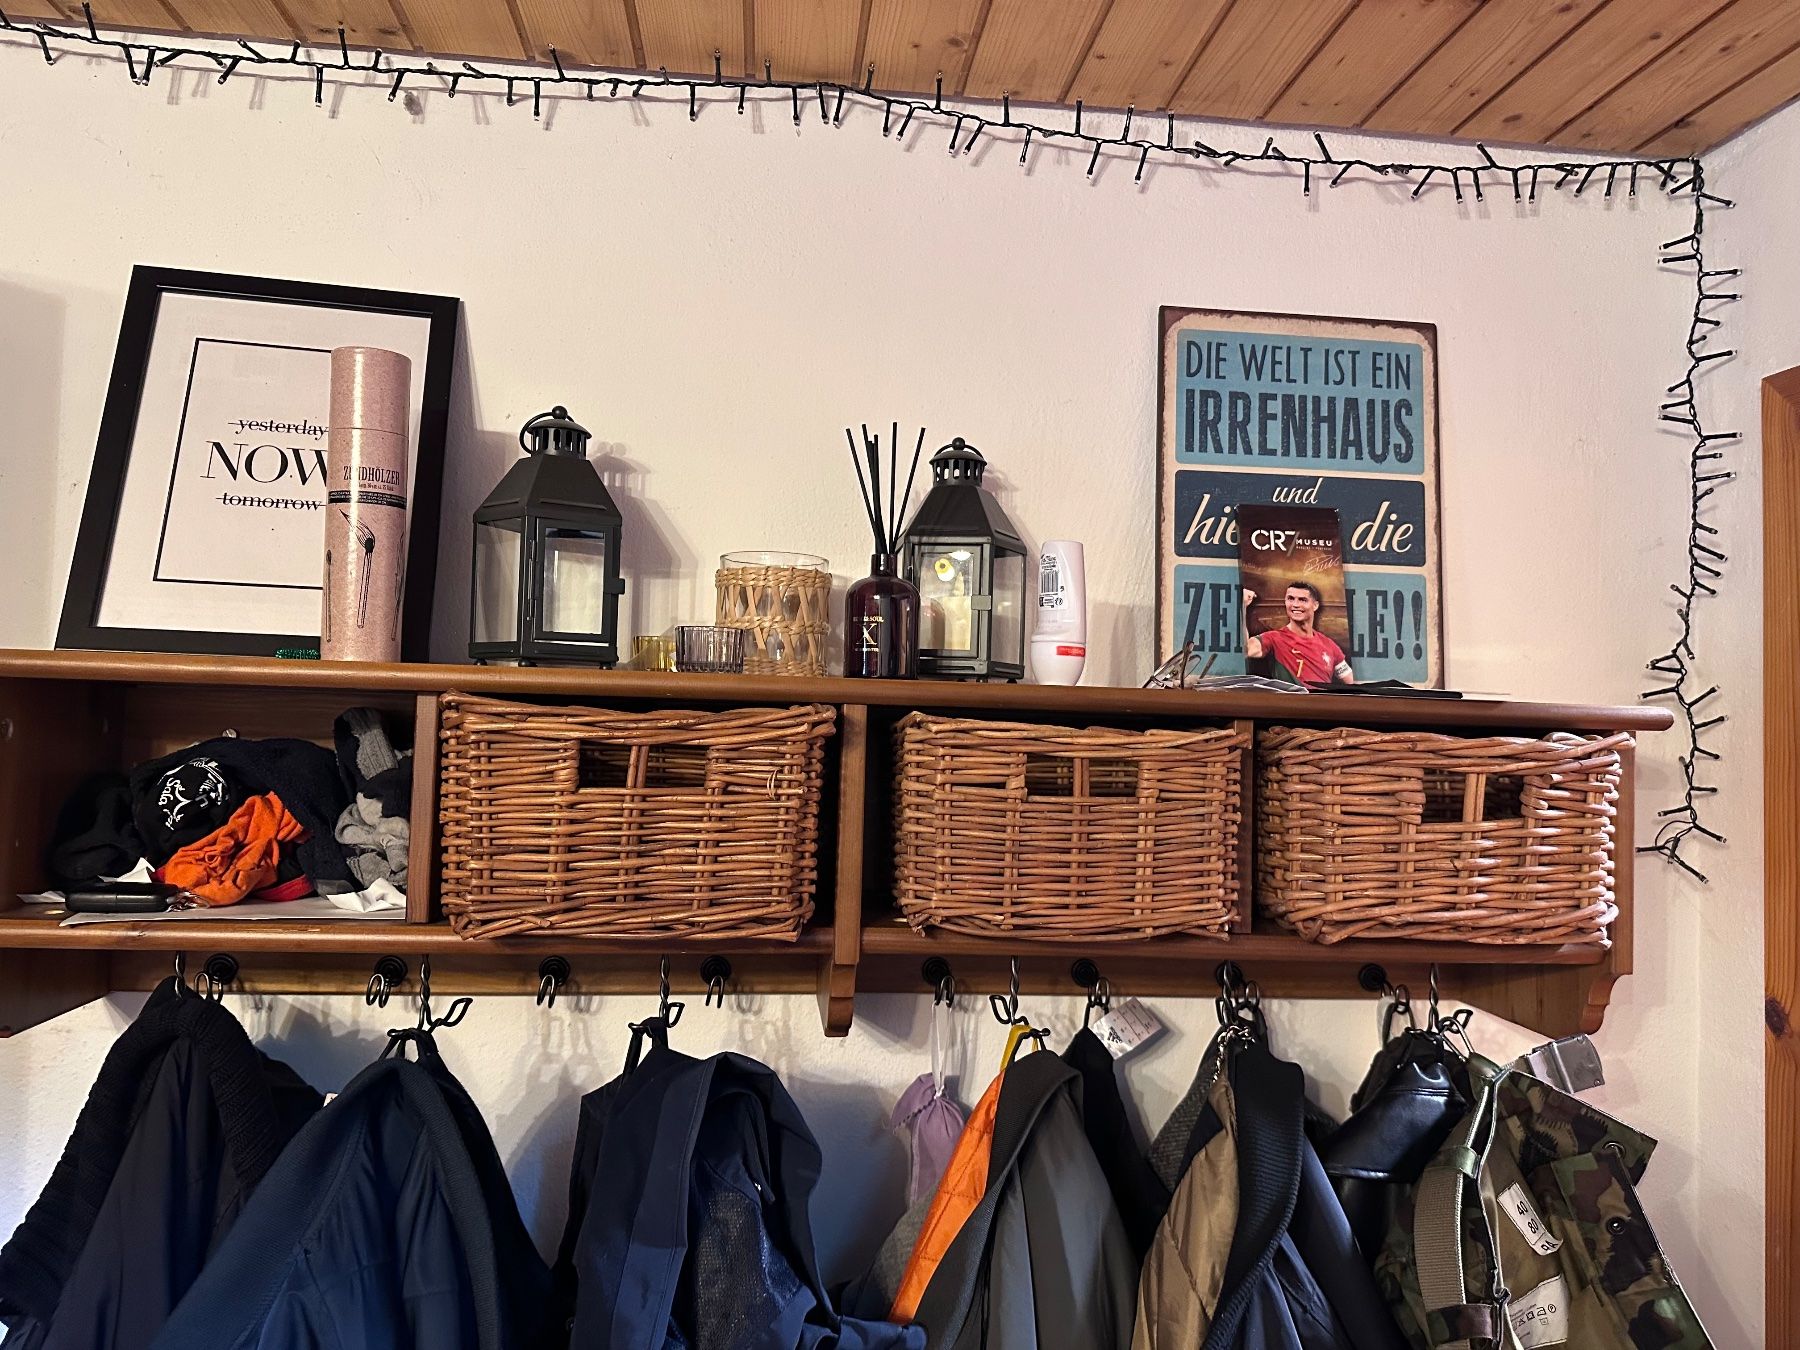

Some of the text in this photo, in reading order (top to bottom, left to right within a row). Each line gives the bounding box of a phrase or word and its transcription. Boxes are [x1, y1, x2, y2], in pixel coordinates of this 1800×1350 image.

[1185, 339, 1411, 391] DIE WELT IST EIN
[234, 418, 329, 440] yesterday
[1184, 388, 1415, 464] IRRENHAUS
[200, 440, 328, 487] NOW
[221, 491, 322, 511] tomorrow
[1272, 477, 1322, 505] und
[1183, 493, 1414, 554] hie die
[1250, 529, 1301, 557] CR7
[1295, 538, 1333, 547] MUSEU
[1295, 659, 1304, 678] 7
[1516, 1200, 1529, 1216] 40
[1527, 1218, 1539, 1234] 80
